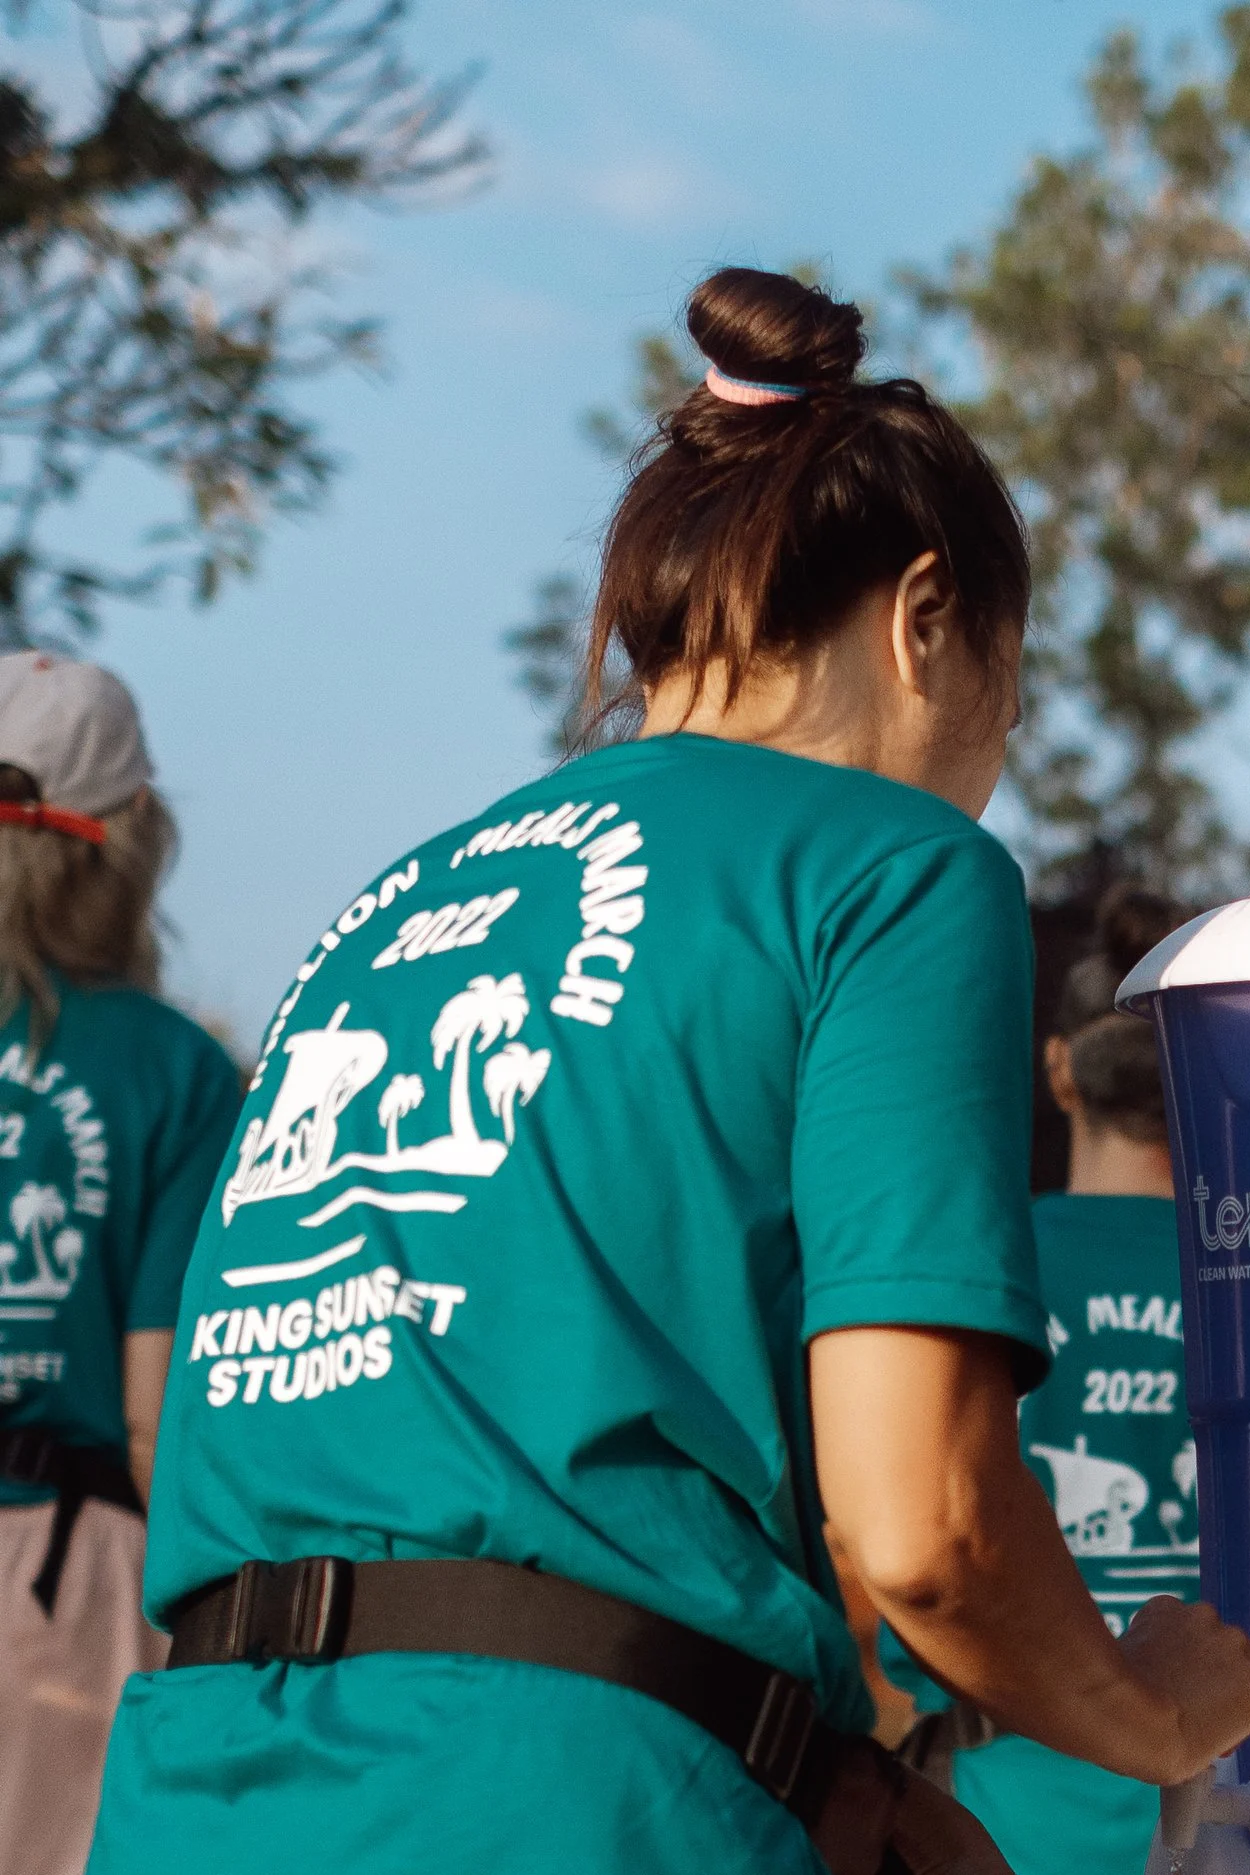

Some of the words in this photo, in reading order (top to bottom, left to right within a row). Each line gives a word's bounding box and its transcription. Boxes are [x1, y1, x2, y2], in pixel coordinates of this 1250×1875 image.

[371, 887, 520, 970] 2022
[550, 820, 649, 1027] MARCH
[1199, 1267, 1226, 1281] CLEAN
[1086, 1294, 1184, 1344] MEAL
[206, 1326, 393, 1408] STUDIOS
[1082, 1368, 1178, 1414] 2022
